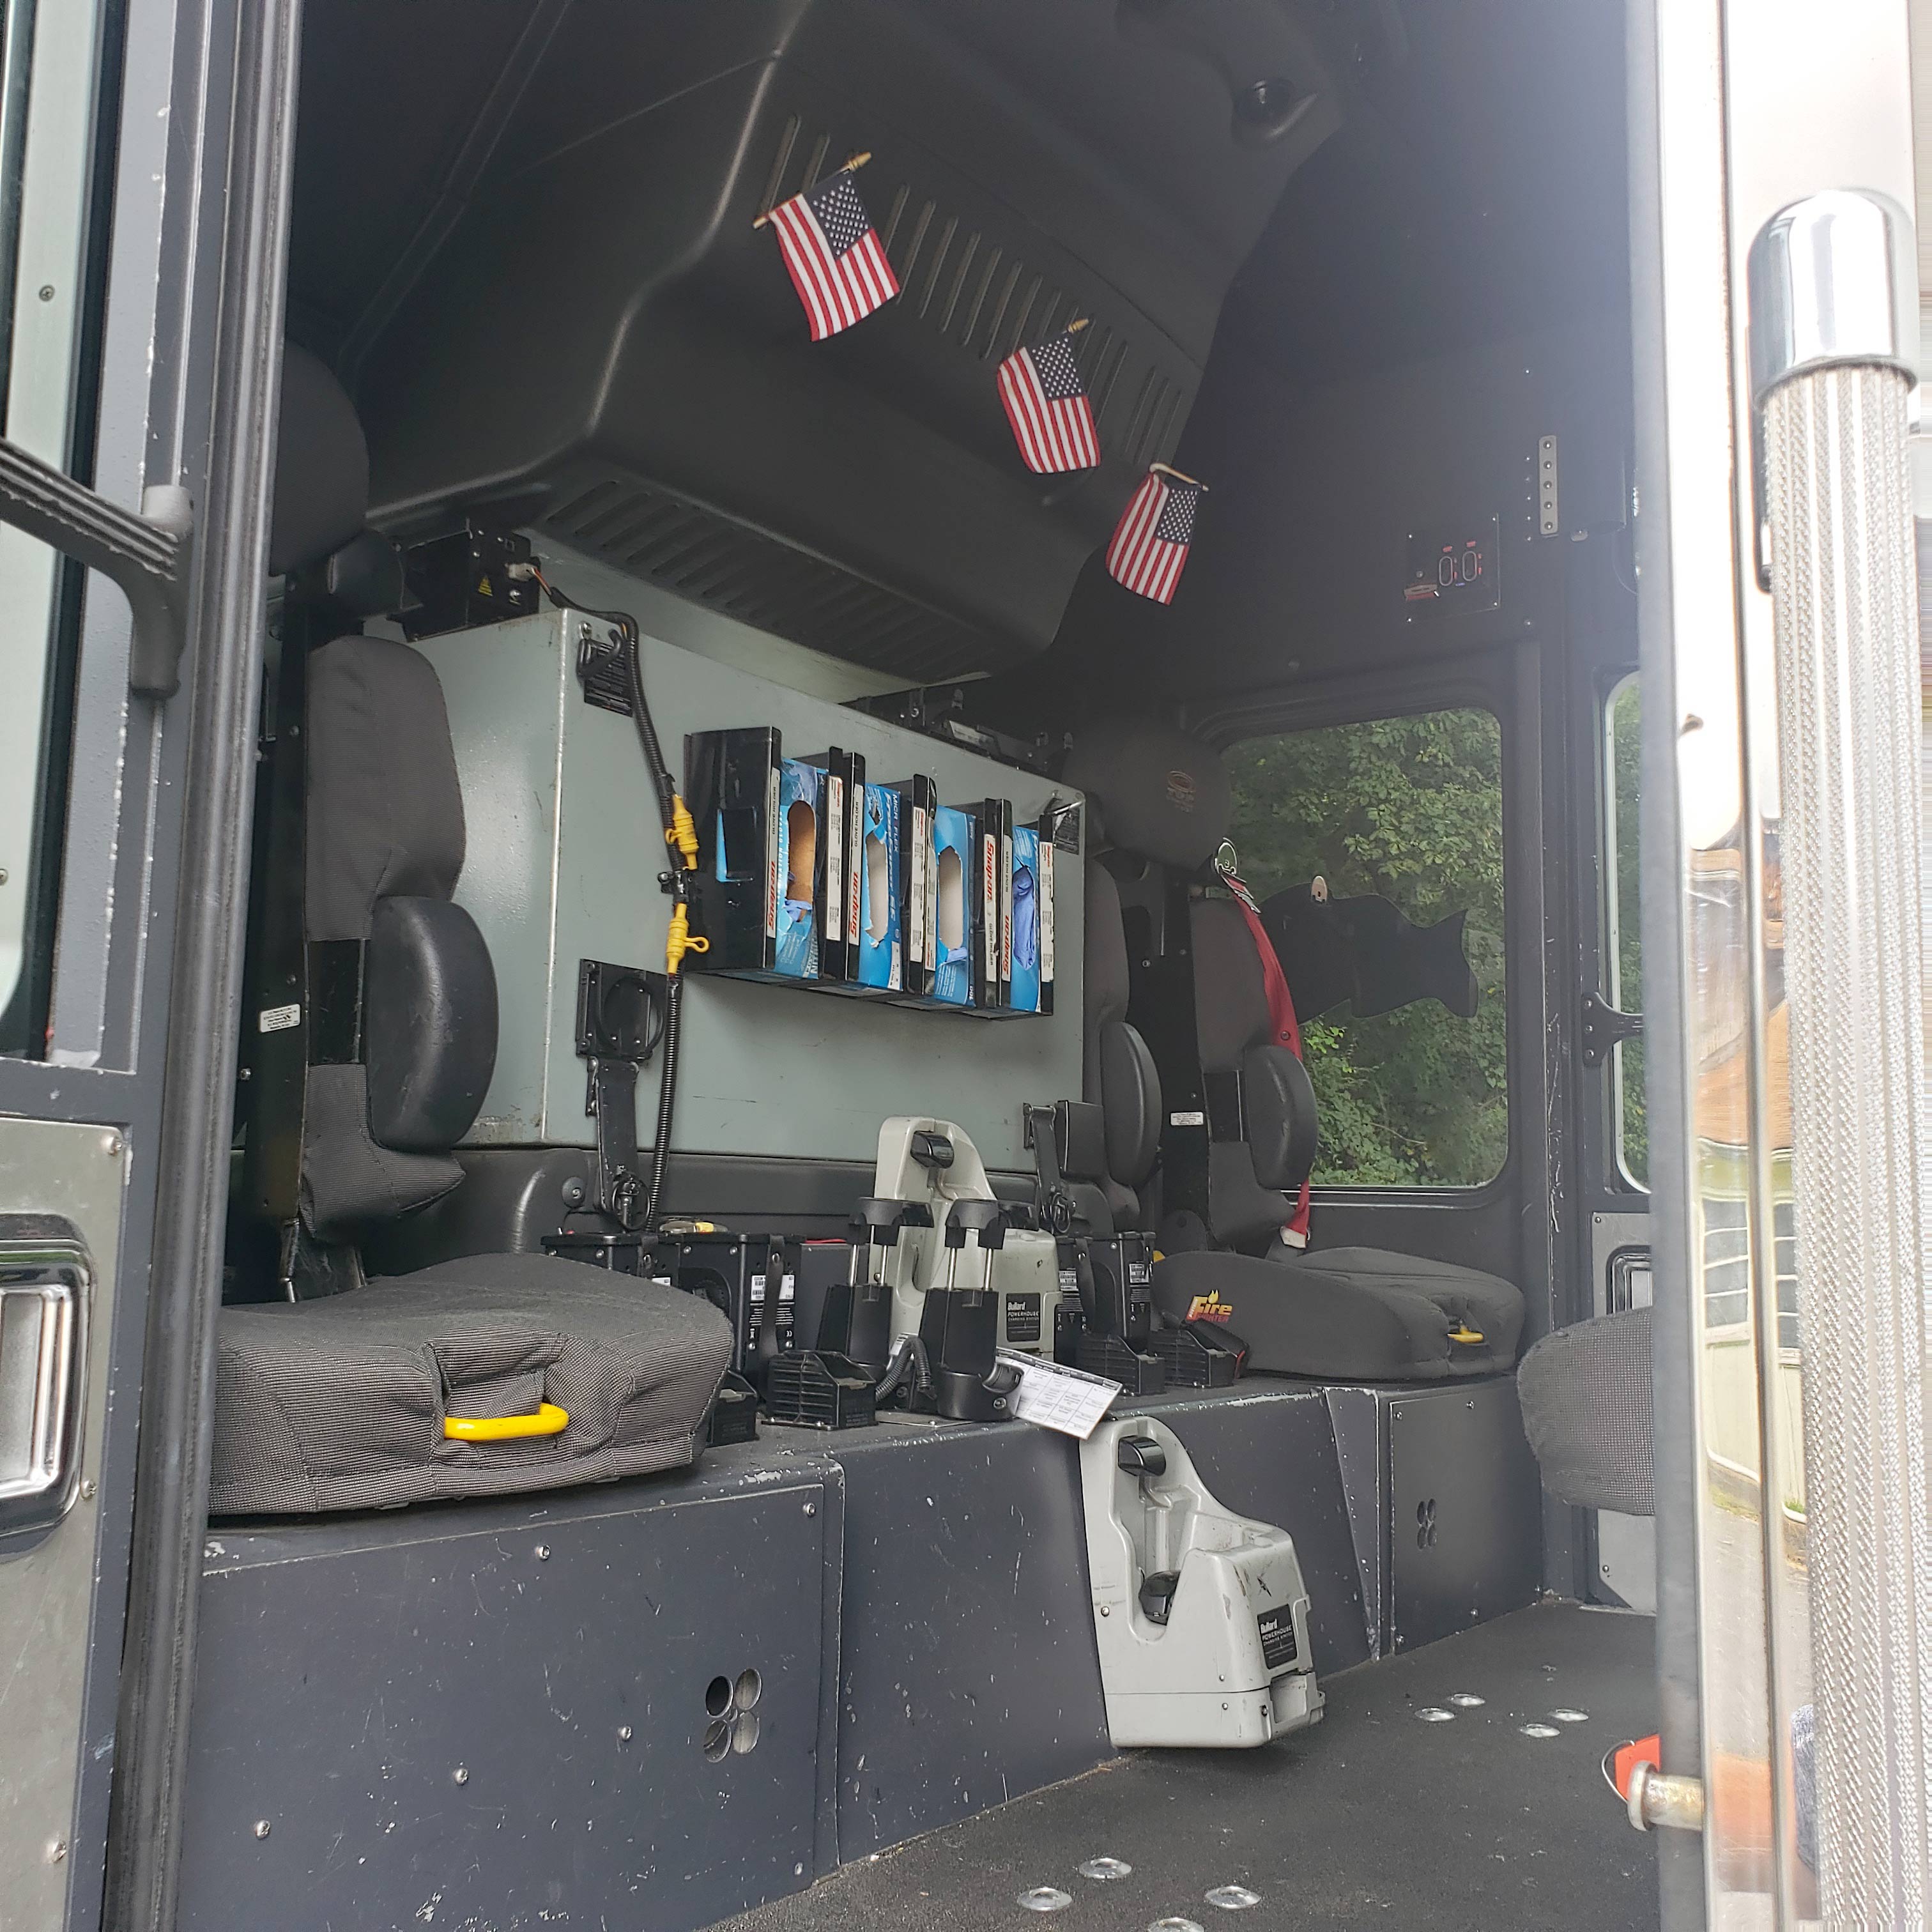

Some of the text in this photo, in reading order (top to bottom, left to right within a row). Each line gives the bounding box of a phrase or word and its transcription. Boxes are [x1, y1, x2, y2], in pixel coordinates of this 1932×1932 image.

[849, 871, 859, 939] Snap-on
[1008, 1301, 1026, 1310] Bullard
[1186, 1290, 1232, 1321] Fire
[1260, 1618, 1278, 1634] Bullard
